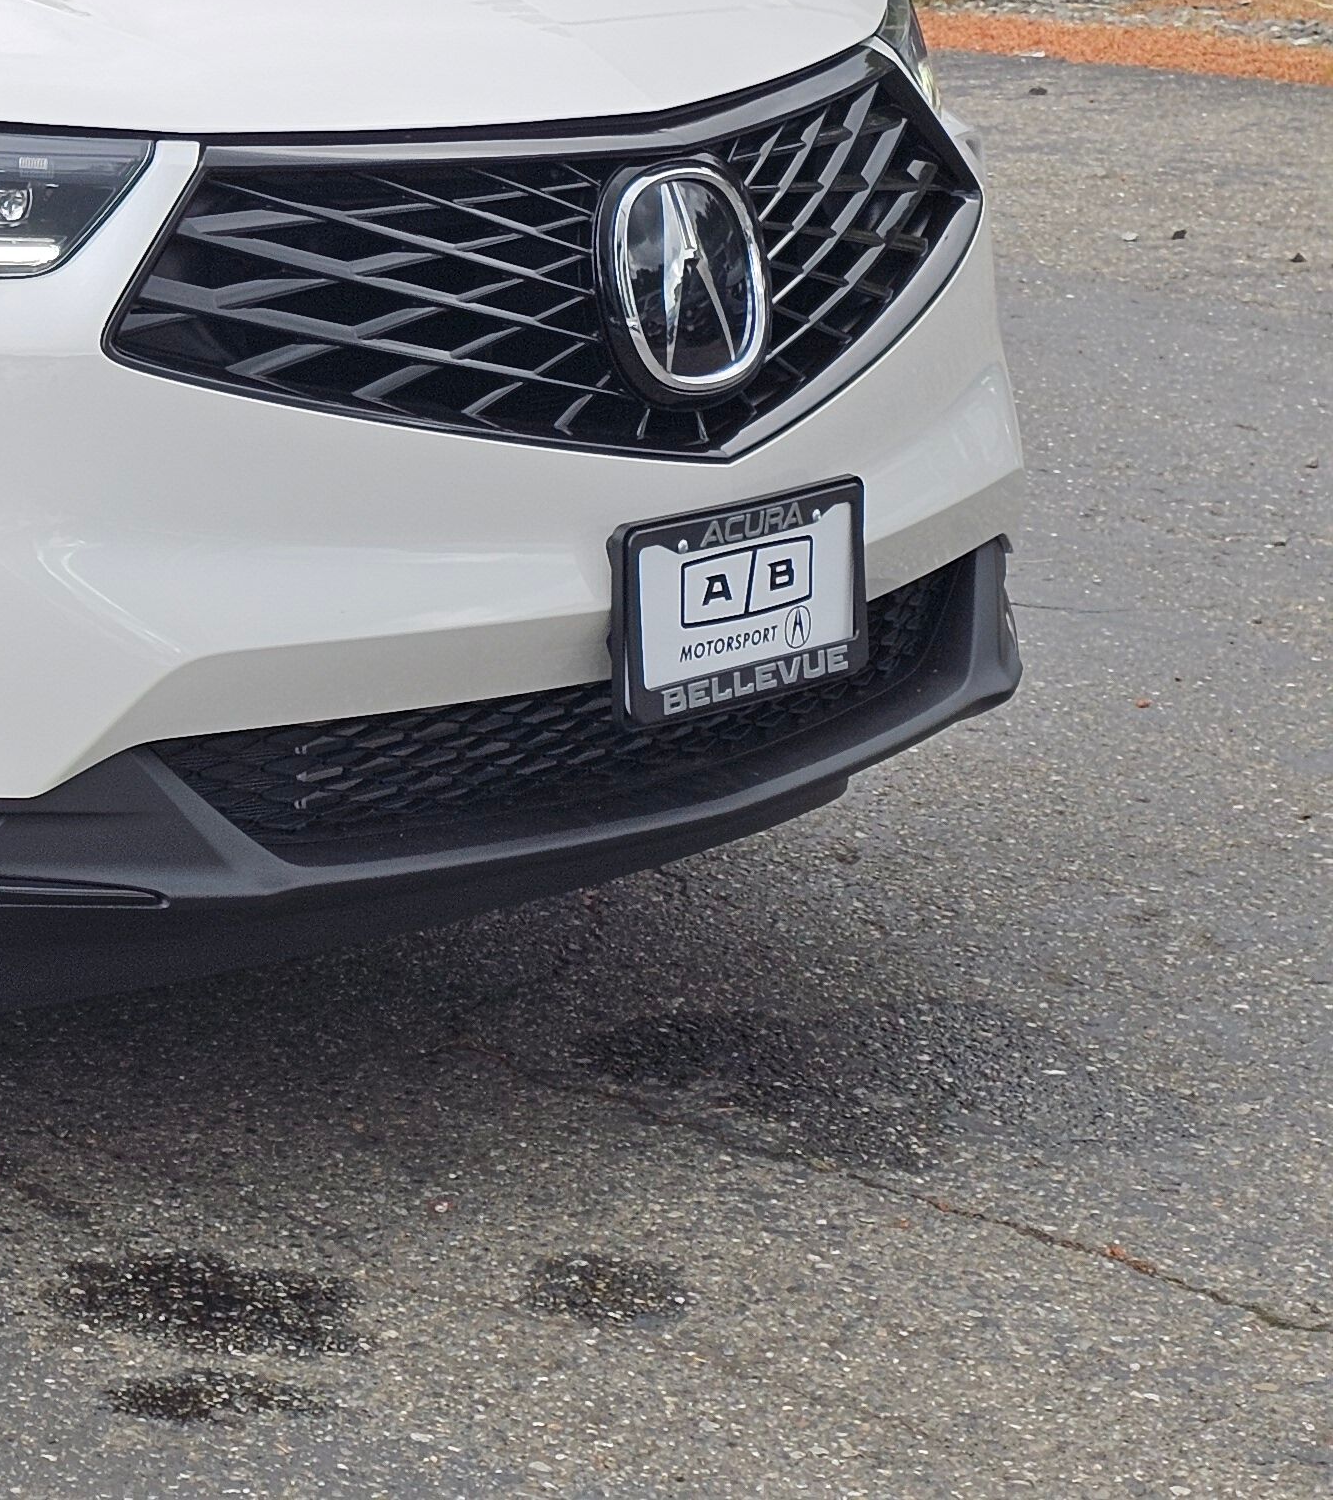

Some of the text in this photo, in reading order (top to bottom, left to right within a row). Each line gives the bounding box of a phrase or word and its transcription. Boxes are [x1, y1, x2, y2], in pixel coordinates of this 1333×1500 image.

[700, 502, 804, 548] ACURA
[701, 558, 795, 606] A B
[679, 625, 778, 663] MOTORSPORT
[661, 645, 849, 716] BELLEVUE
